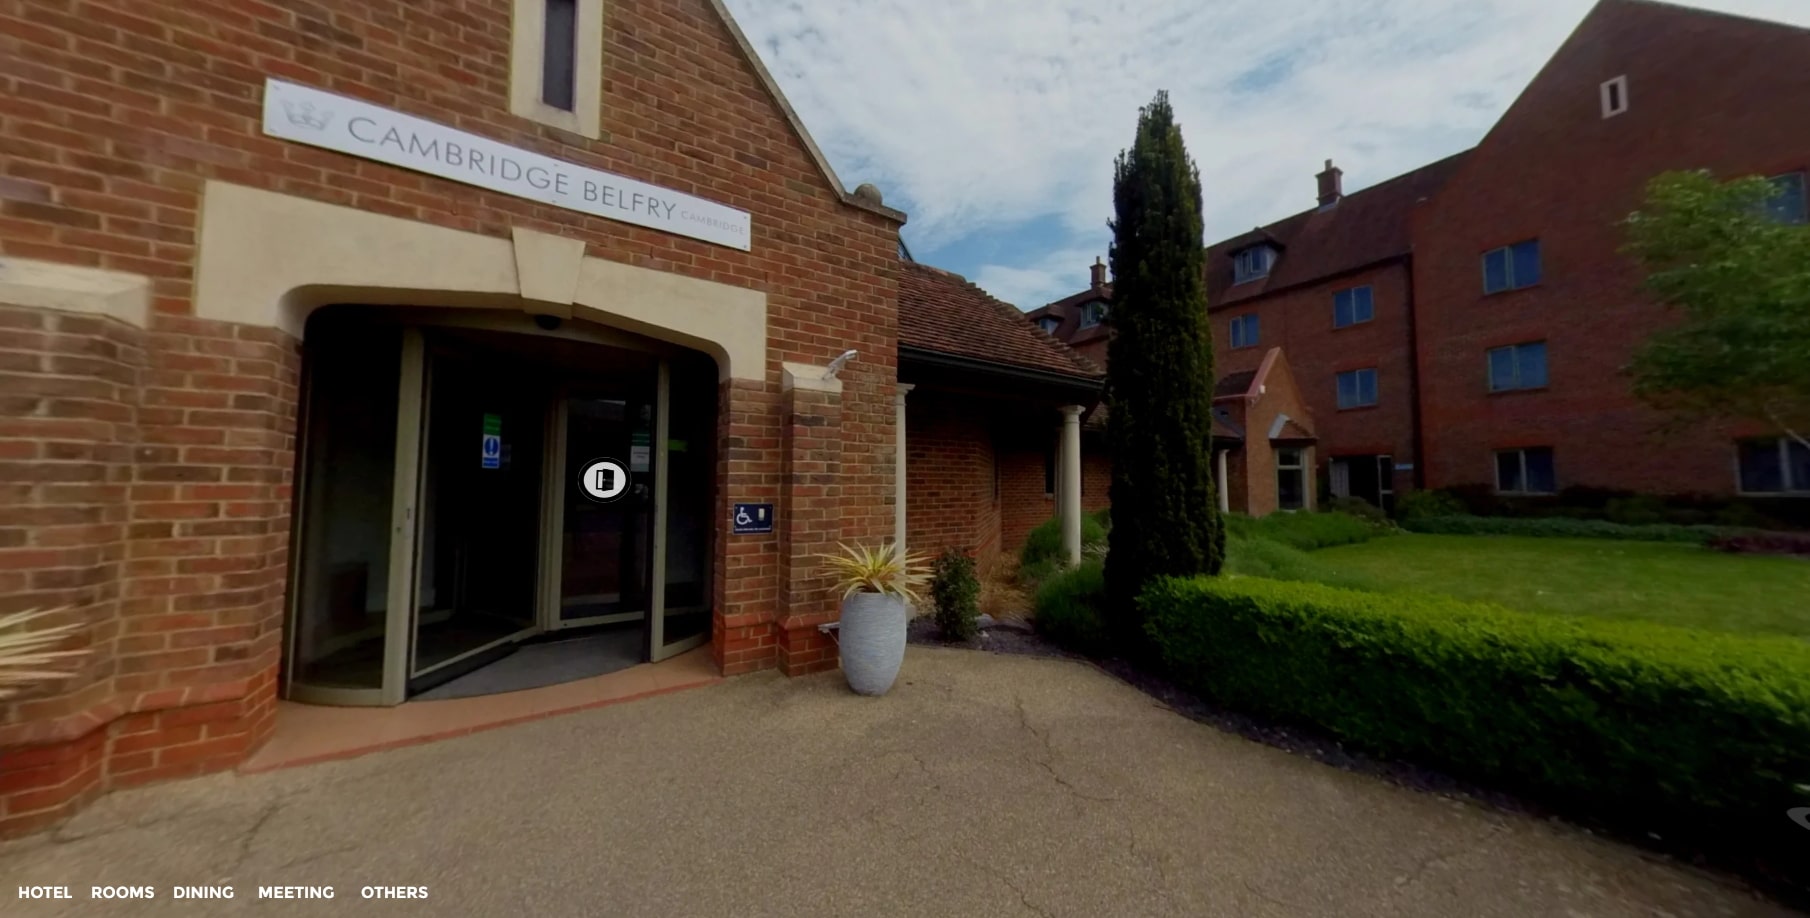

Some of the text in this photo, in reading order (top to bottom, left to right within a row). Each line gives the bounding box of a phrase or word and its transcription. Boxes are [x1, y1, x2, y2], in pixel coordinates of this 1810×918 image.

[347, 116, 745, 235] CAMBRIDGE BELFRY CAMBRIDGE
